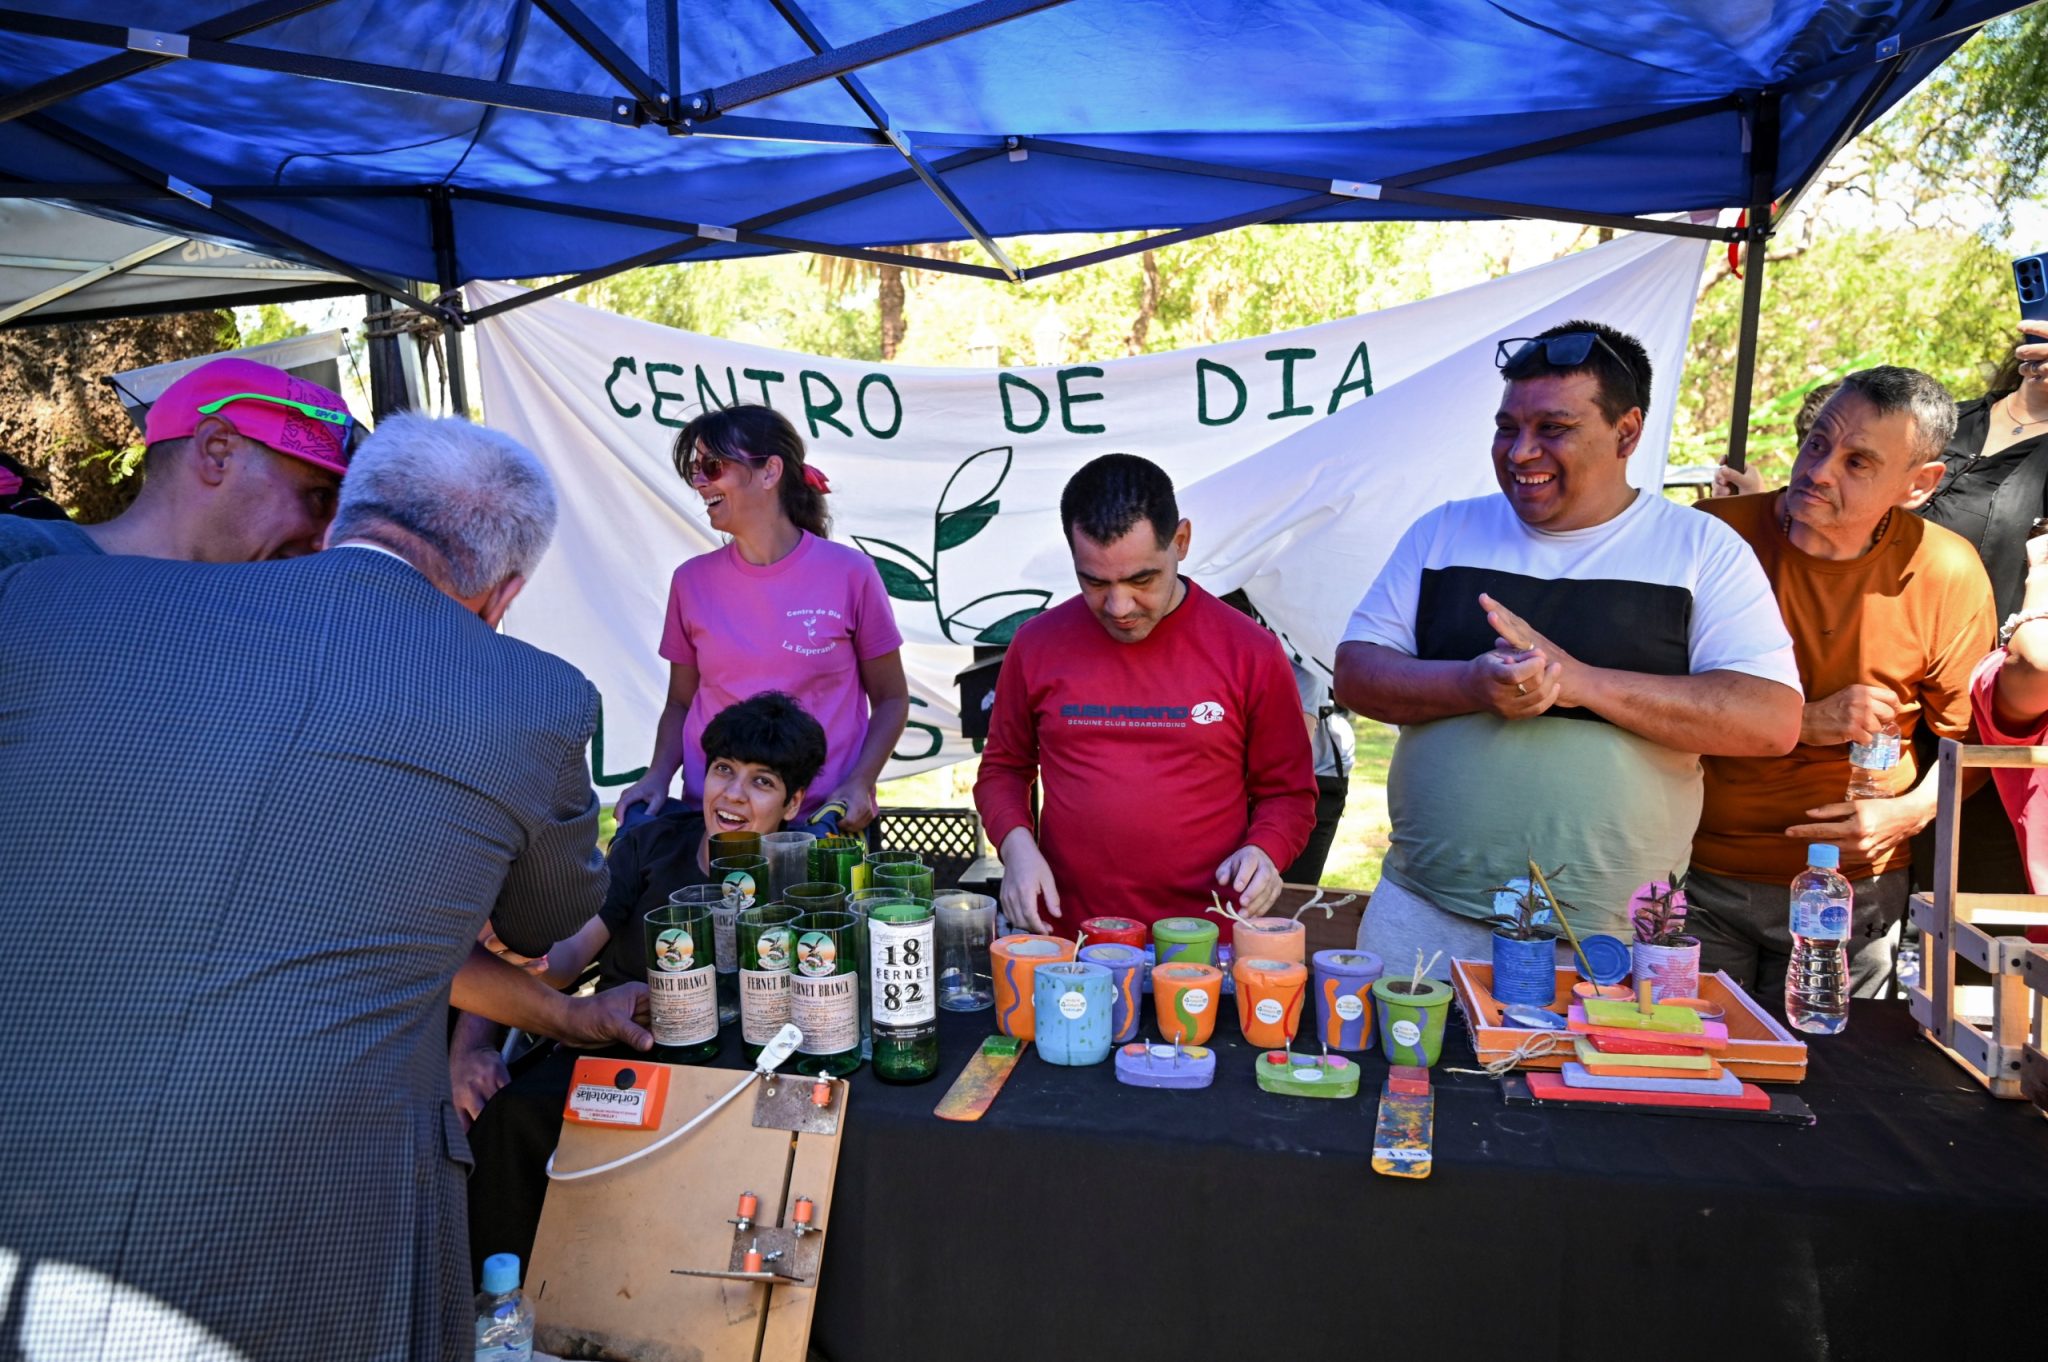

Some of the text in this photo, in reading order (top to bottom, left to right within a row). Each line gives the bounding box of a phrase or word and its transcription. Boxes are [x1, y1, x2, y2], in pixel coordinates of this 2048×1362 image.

[605, 341, 1374, 439] CENTRO DE DIA
[786, 609, 814, 617] Centro
[782, 639, 793, 651] La
[884, 938, 921, 967] 18
[876, 966, 929, 980] FERNET
[678, 974, 708, 991] BRANCA
[747, 976, 776, 990] FERNET
[818, 981, 849, 997] BRANCA
[884, 983, 925, 1011] 82
[576, 1089, 640, 1106] Cortabotellas
